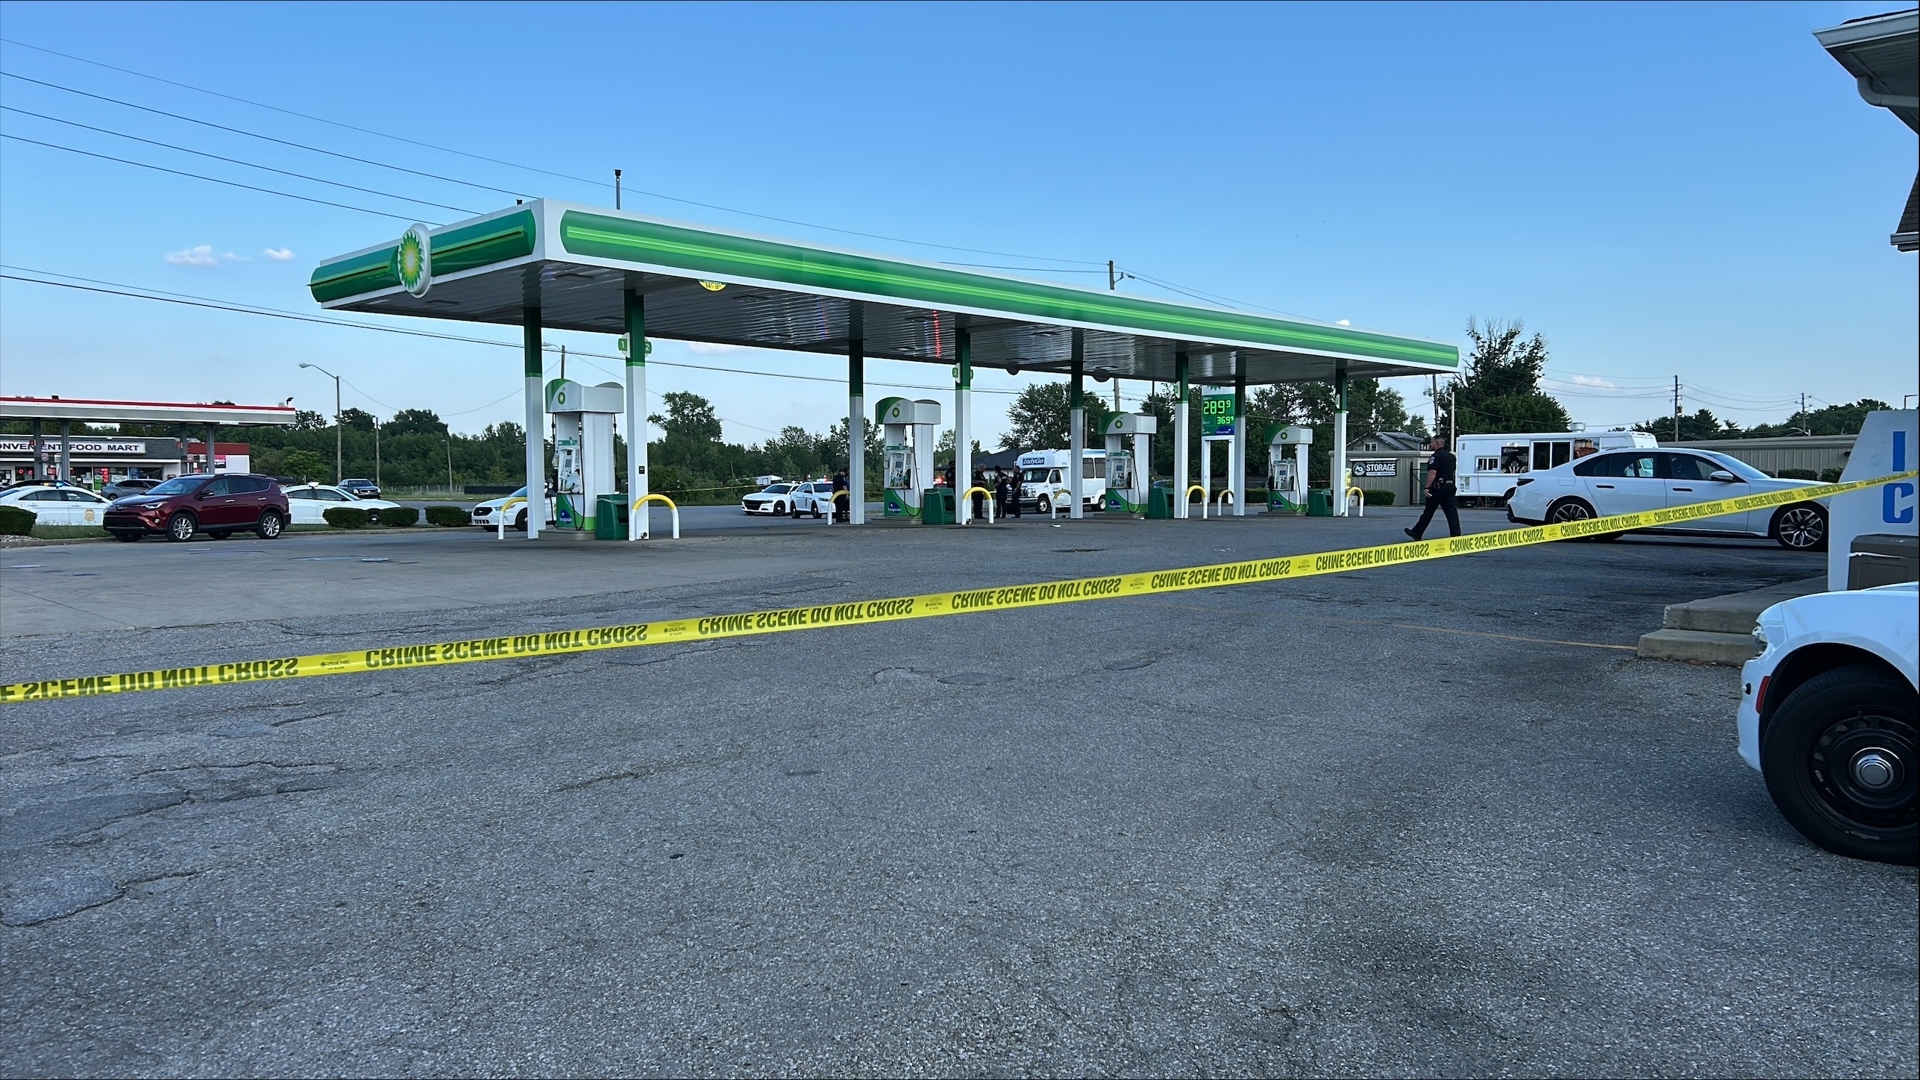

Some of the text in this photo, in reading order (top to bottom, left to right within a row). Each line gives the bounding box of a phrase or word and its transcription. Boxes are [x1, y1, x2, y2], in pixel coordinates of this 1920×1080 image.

[69, 443, 102, 451] FOOD
[107, 444, 140, 452] MART
[1366, 463, 1396, 472] STORAGE
